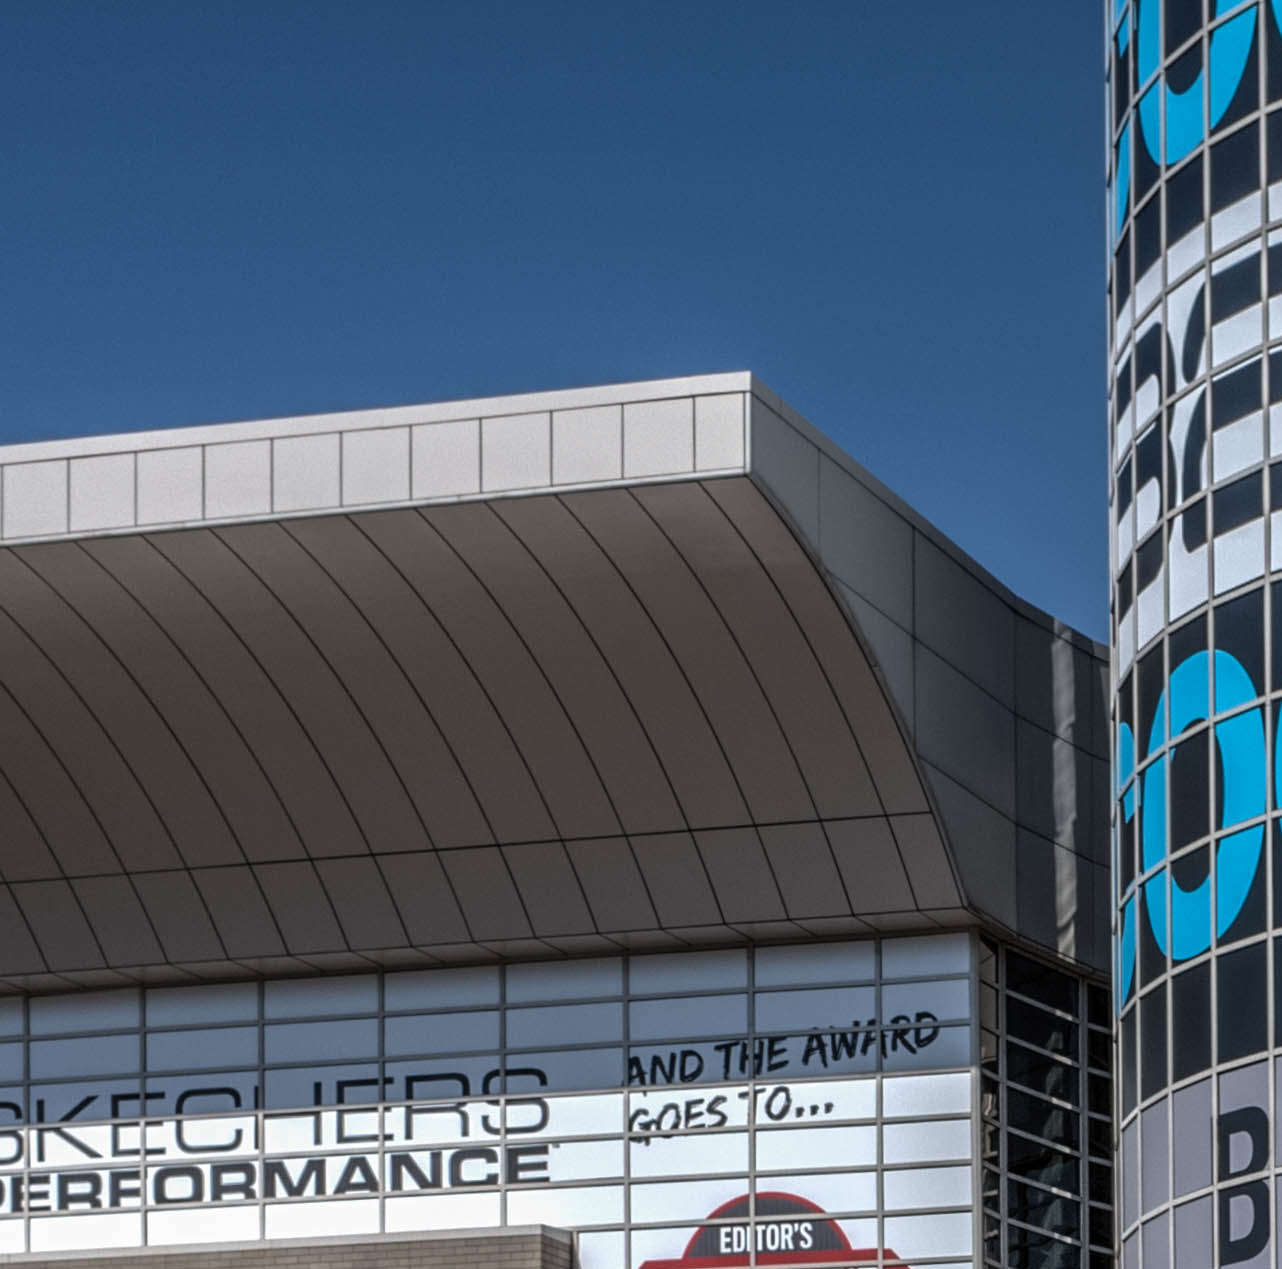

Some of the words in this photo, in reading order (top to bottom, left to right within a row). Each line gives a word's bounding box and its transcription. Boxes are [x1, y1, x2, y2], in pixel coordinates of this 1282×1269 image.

[622, 1050, 704, 1087] AND
[715, 1036, 789, 1080] THE
[802, 1012, 940, 1068] AWARD
[629, 1095, 728, 1145] GOES
[0, 1143, 550, 1214] ERFORMANCE
[720, 1222, 813, 1253] EDITOR'S
